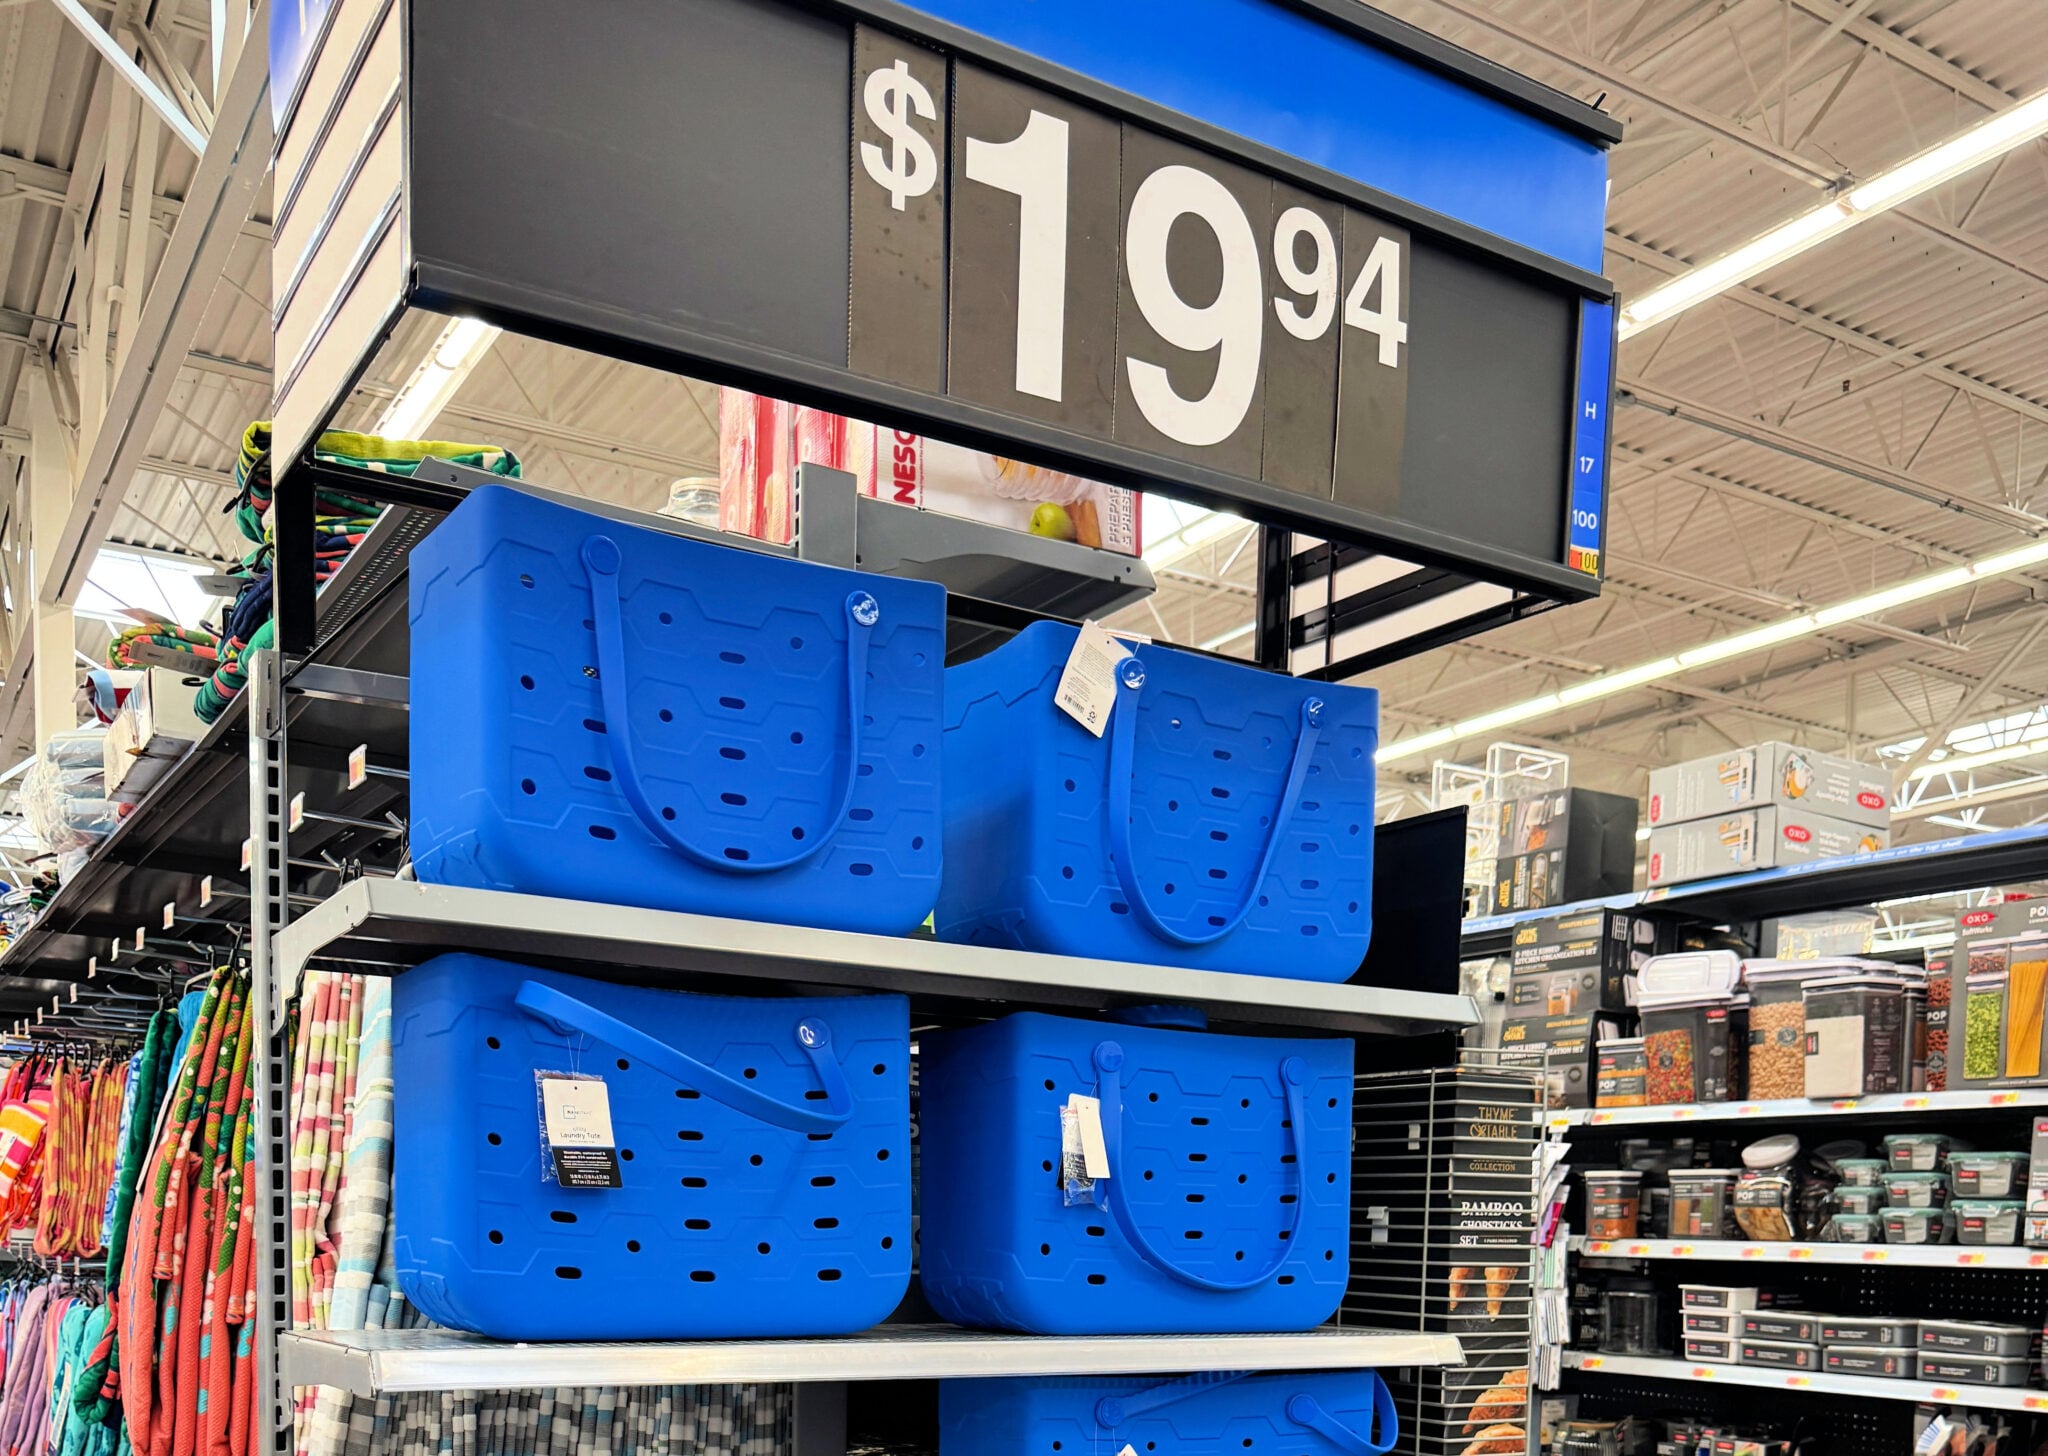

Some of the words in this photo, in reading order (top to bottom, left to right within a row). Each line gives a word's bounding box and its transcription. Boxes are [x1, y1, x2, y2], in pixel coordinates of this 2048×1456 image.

[1585, 401, 1597, 420] H
[1580, 456, 1595, 474] 17
[1573, 509, 1597, 530] 100
[1579, 552, 1599, 570] 100
[1861, 795, 1880, 807] OXO
[1788, 828, 1807, 840] OXO
[2029, 906, 2048, 918] PO
[1966, 913, 1989, 924] OXO
[1927, 1010, 1947, 1021] POP
[1599, 1080, 1616, 1089] POP
[1478, 1106, 1516, 1121] THYME
[560, 1132, 586, 1140] Laundry
[1469, 1162, 1517, 1172] COLLECTION
[1461, 1201, 1525, 1217] BAMBOO
[1459, 1235, 1479, 1246] SET
